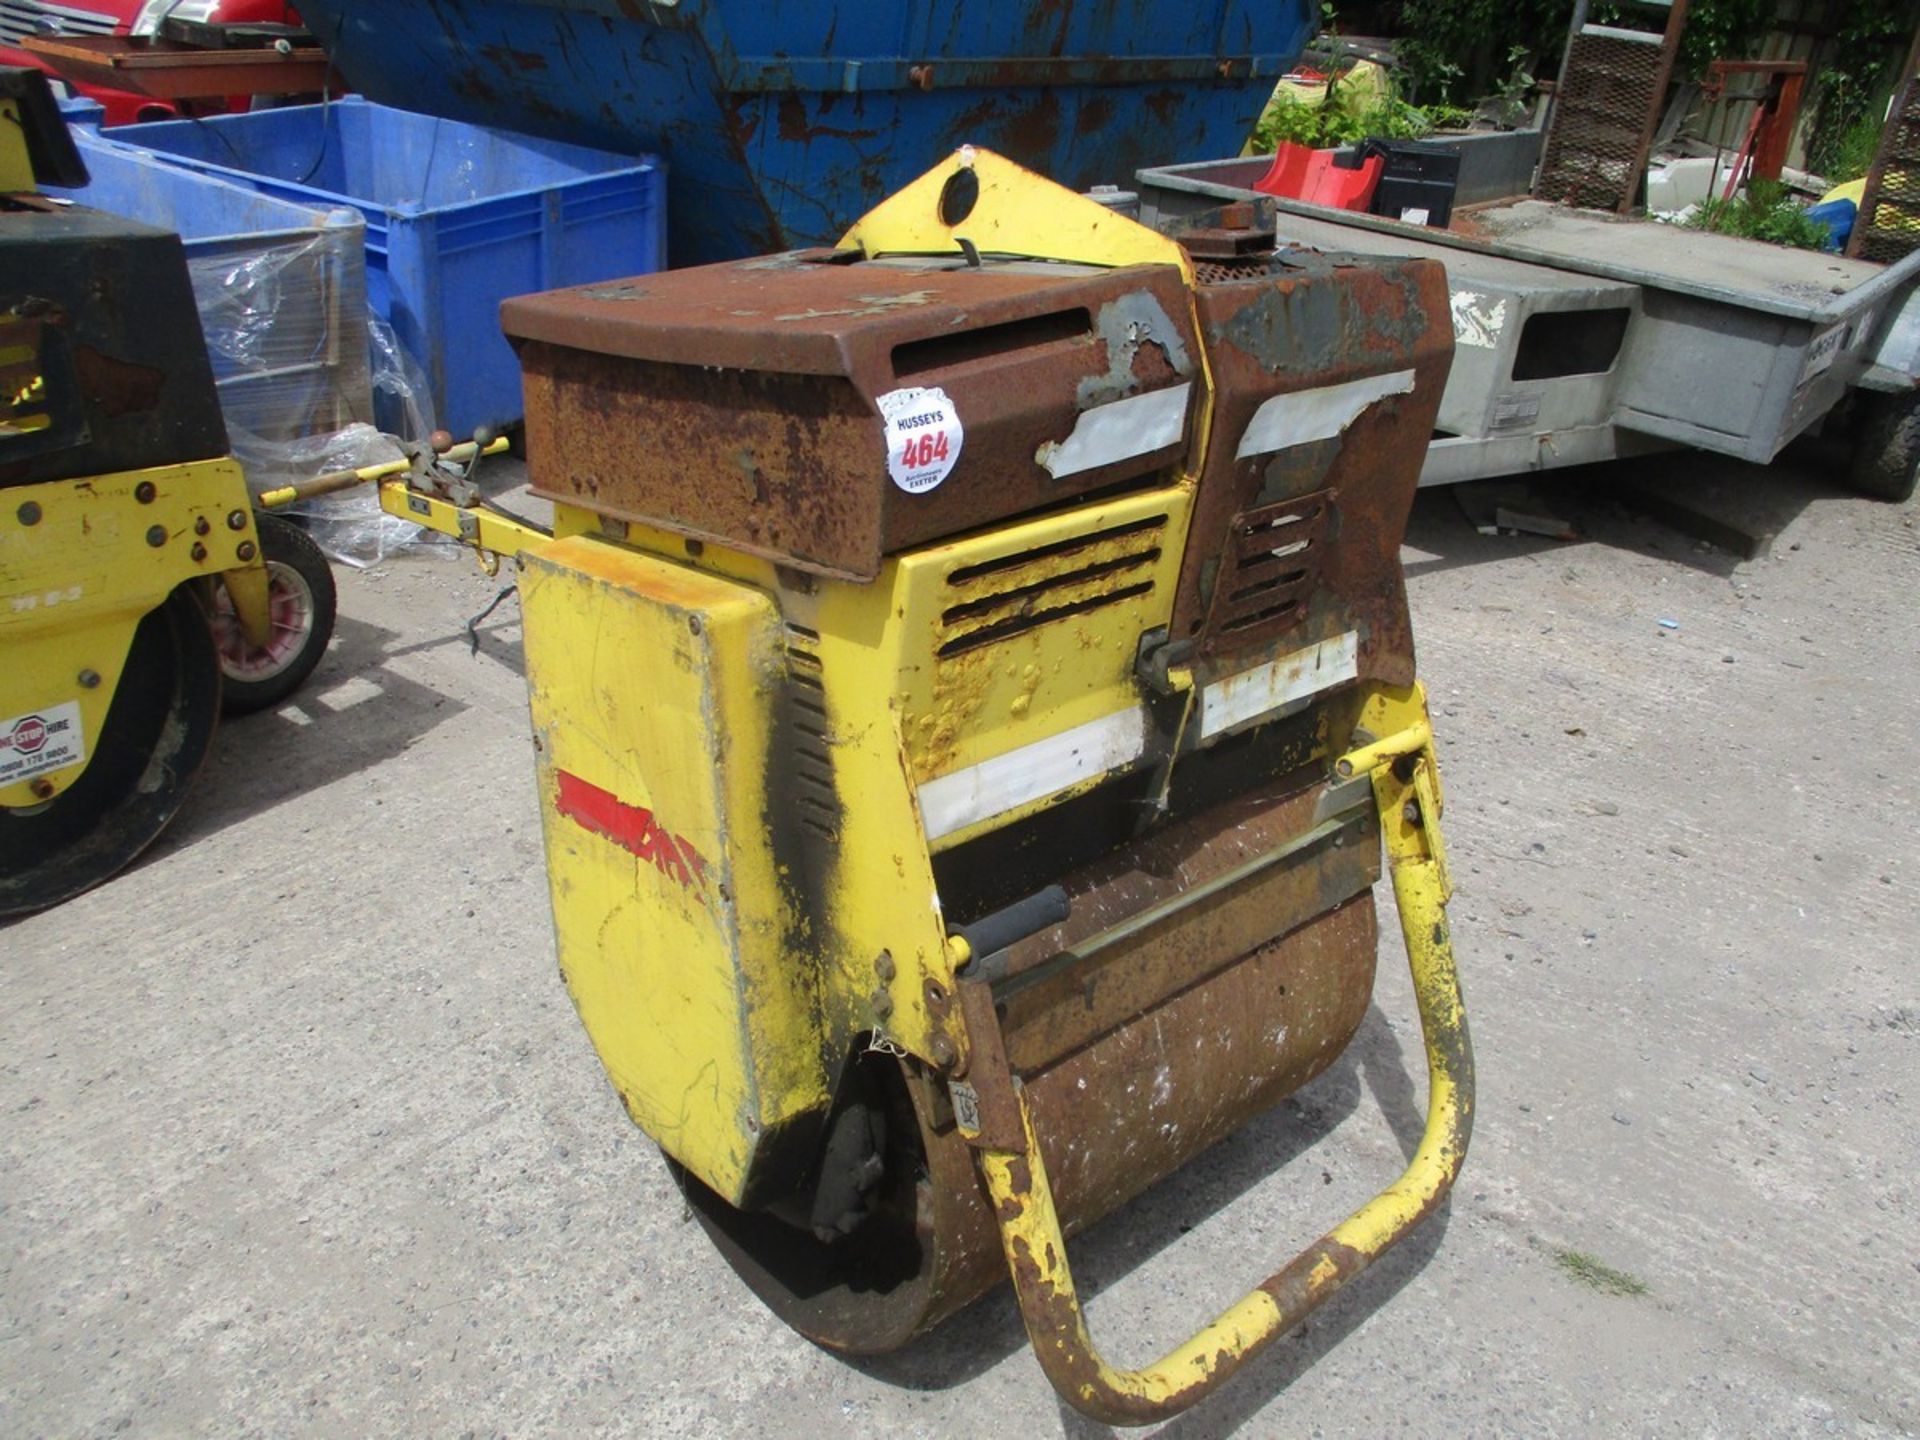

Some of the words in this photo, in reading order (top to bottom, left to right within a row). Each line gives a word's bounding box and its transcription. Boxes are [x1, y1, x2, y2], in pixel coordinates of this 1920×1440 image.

[897, 410, 944, 430] HUSSEYS
[902, 430, 948, 469] 464
[909, 475, 938, 488] EXETER
[0, 735, 15, 750] NE
[17, 727, 43, 744] STOP
[46, 719, 70, 734] HIRE
